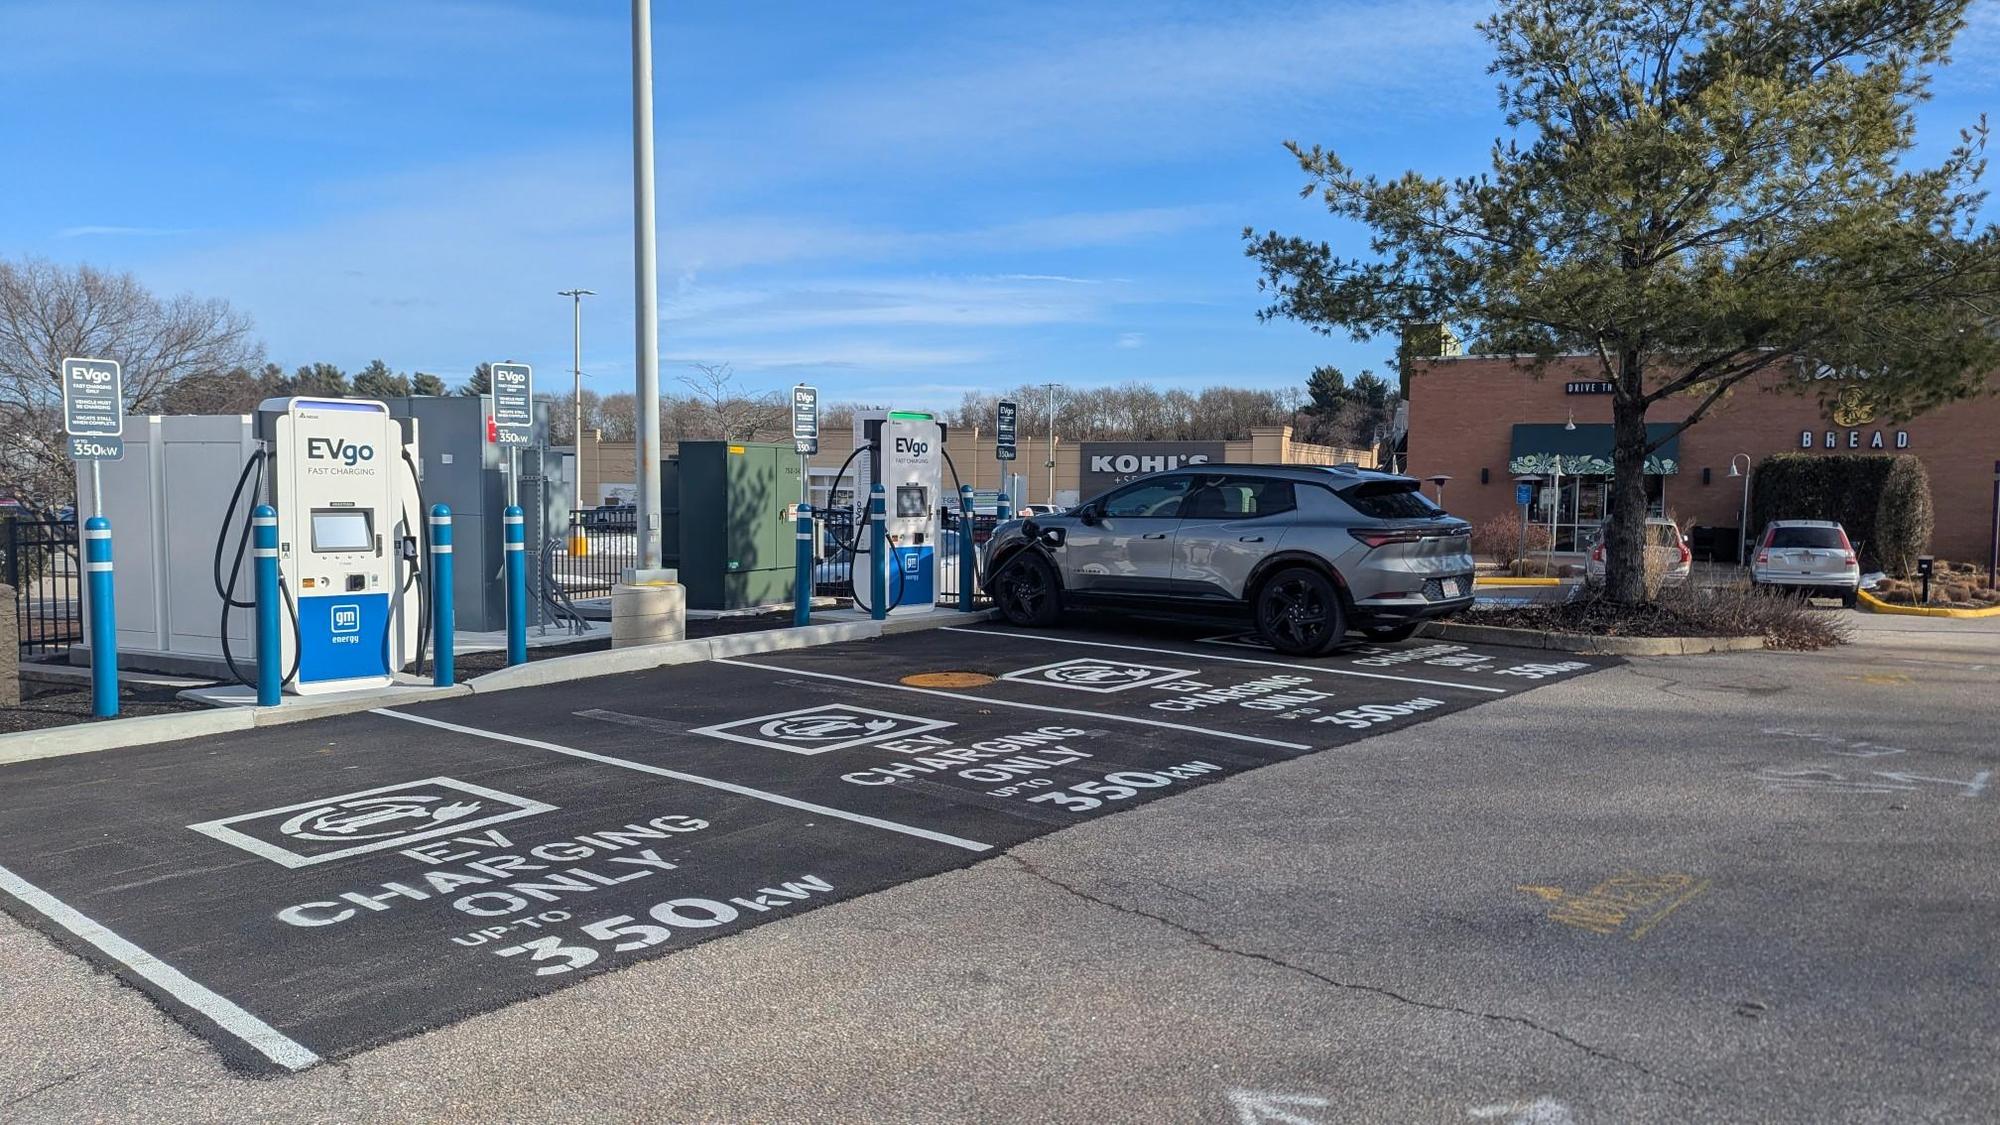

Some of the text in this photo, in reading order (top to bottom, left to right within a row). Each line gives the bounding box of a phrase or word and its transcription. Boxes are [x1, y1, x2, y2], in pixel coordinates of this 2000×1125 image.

[72, 367, 111, 384] EVgo
[498, 370, 526, 384] EVgo
[1568, 383, 1595, 392] DRIVE
[796, 392, 814, 404] EVgo
[1000, 406, 1015, 416] EVgo
[500, 433, 528, 443] 350kW
[896, 437, 928, 457] EVgo
[1803, 431, 1908, 448] BREAD
[74, 444, 118, 457] 350kW
[308, 437, 374, 467] EVgo
[308, 467, 375, 476] FAST CHARGING
[336, 611, 355, 626] gm
[332, 634, 359, 644] energy
[1150, 674, 1313, 712] CHARGING
[1151, 680, 1213, 692] EV
[1239, 688, 1335, 711] ONLY
[874, 734, 955, 755] EV
[840, 726, 1086, 786] CHARGING
[958, 745, 1093, 783] ONLY
[985, 778, 1053, 797] UP TO
[1026, 760, 1224, 812] 350kW
[399, 829, 513, 865] EV
[276, 814, 710, 928] CHARGING
[452, 848, 680, 918] ONLY
[451, 910, 572, 946] UP TO
[495, 873, 836, 976] 350kW
